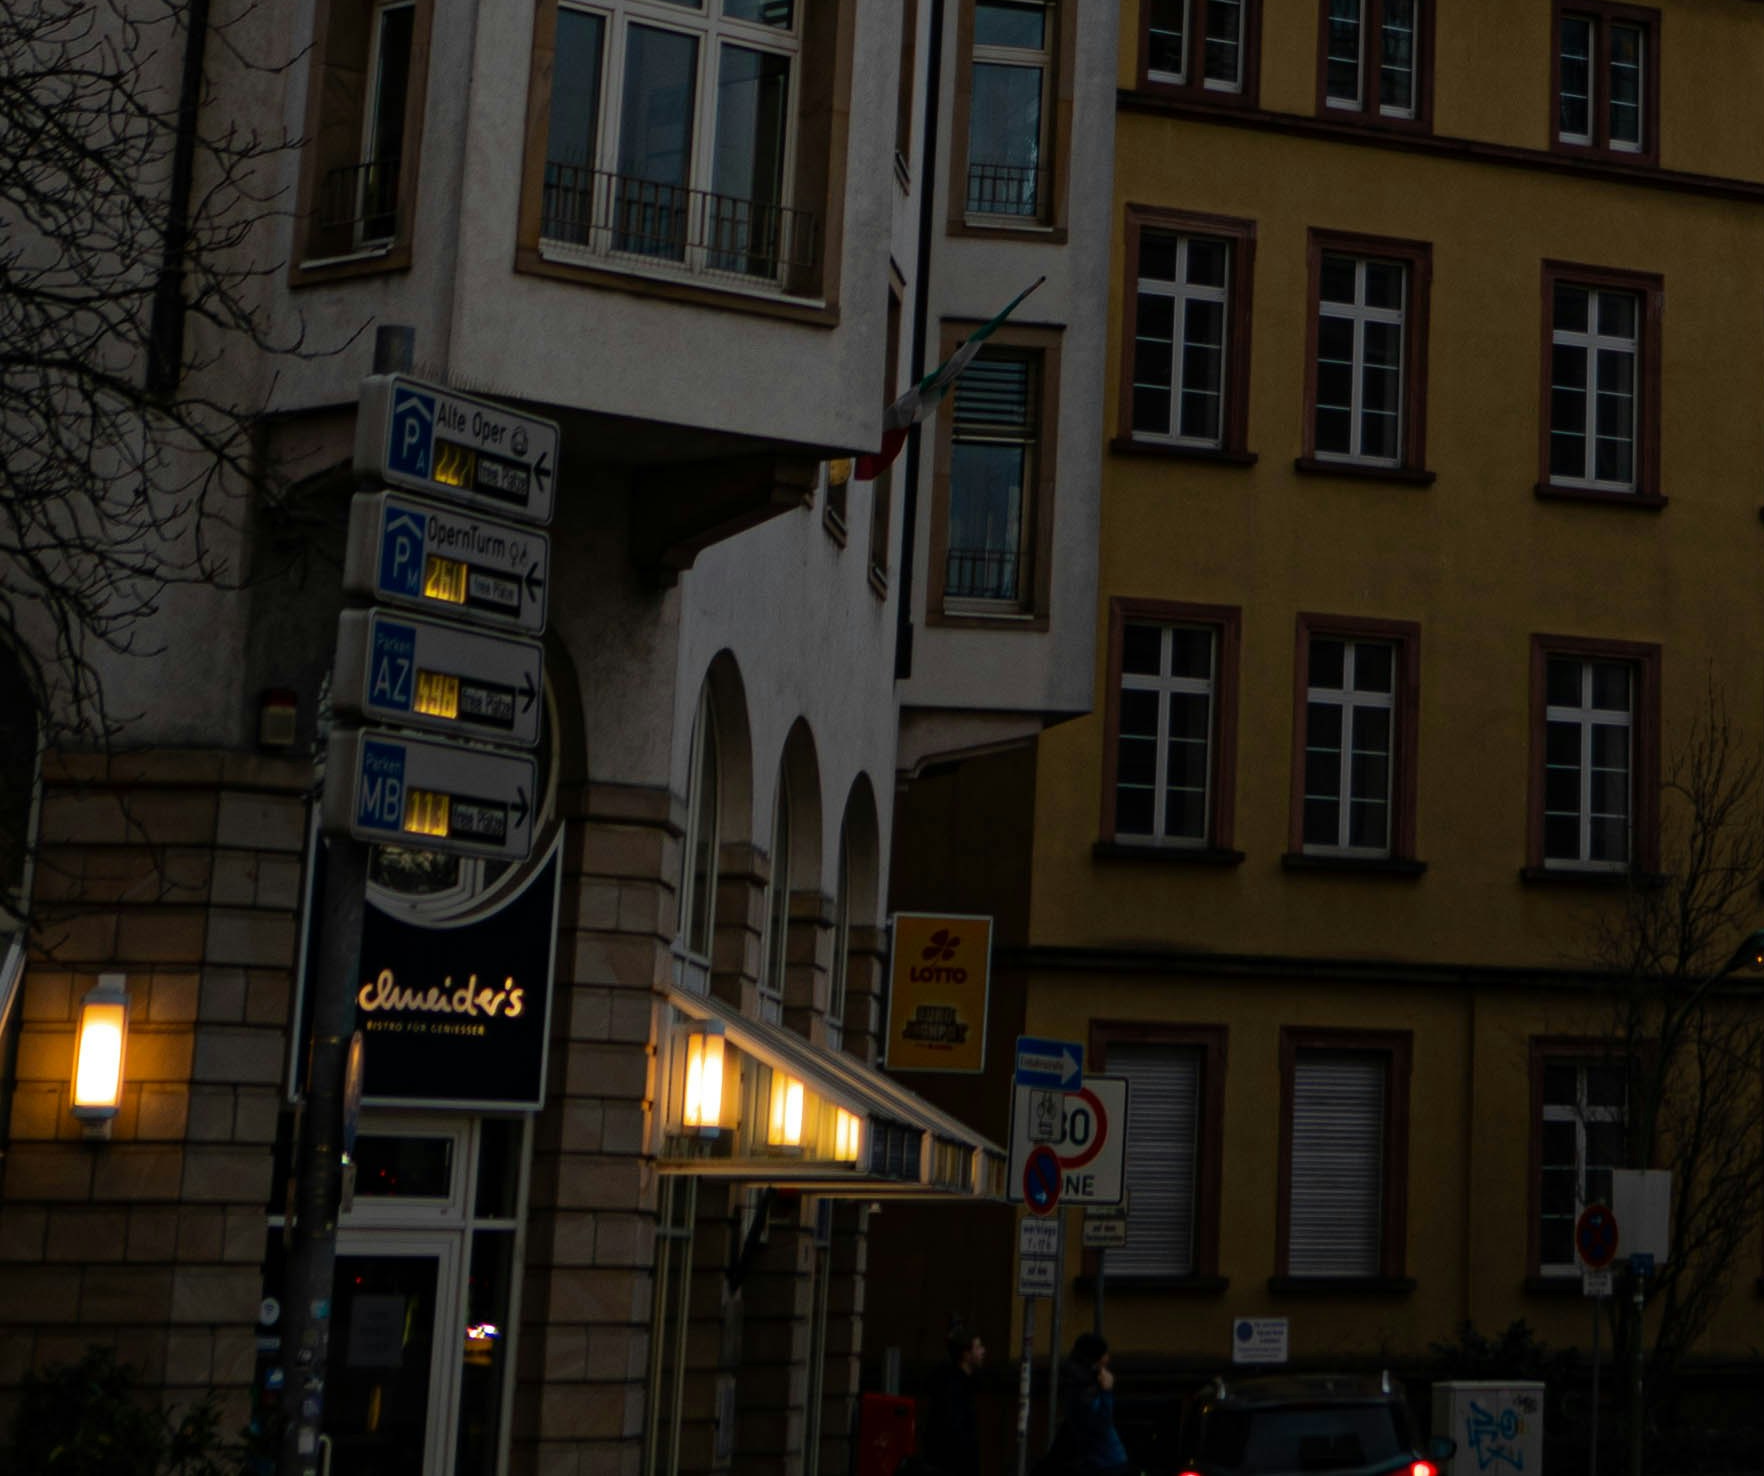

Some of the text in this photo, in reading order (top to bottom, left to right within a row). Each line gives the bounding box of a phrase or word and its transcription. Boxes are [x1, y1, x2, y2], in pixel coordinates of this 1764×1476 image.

[436, 402, 507, 446] Alte Oper
[428, 515, 505, 559] OpernTurm
[373, 654, 411, 704] AZ
[359, 774, 401, 823] MB
[355, 967, 527, 1018] chneider's
[910, 967, 967, 984] LOTTO
